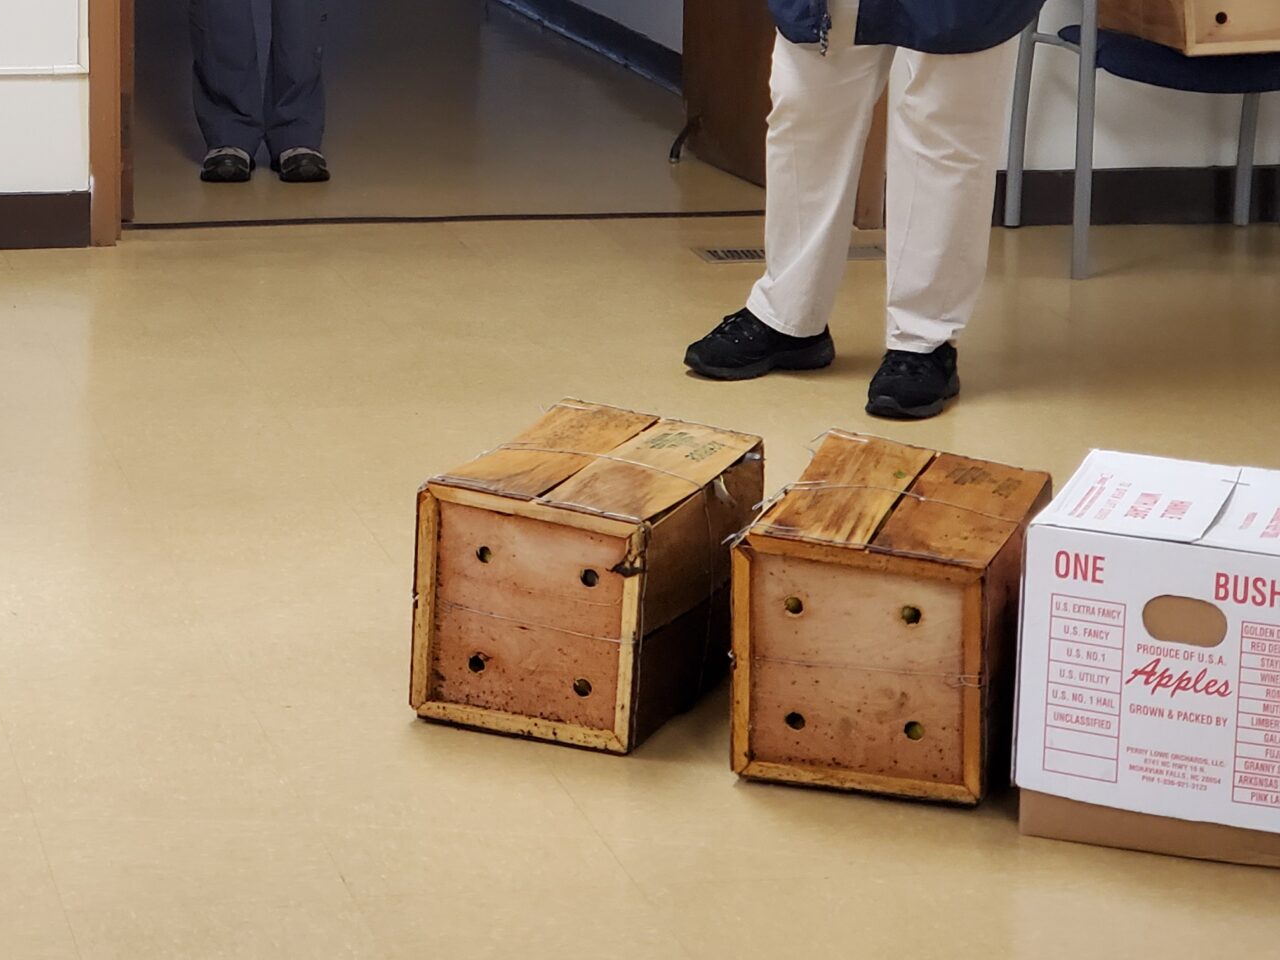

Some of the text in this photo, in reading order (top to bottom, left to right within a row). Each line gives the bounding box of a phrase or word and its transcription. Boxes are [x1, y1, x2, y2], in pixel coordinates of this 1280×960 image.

[1055, 550, 1280, 608] ONE BUSH
[1055, 601, 1122, 620] U.S. EXTRA FANCY
[1064, 625, 1110, 640] U.S. FANCY
[1243, 625, 1275, 638] GOLDEN
[1066, 648, 1083, 659] U.S.
[1251, 641, 1266, 652] RED
[1137, 644, 1226, 666] PRODUCE OF U.S.A.
[1059, 669, 1110, 685] U.S. UTILITY
[1125, 658, 1232, 698] Apples
[1052, 689, 1069, 701] U.S.
[1072, 693, 1086, 704] NO.
[1096, 697, 1115, 709] HAIL
[1053, 711, 1112, 730] UNCLASSIFIED
[1129, 703, 1228, 727] GROWN & PACKED BY
[1126, 746, 1148, 755] PERRY
[1128, 764, 1165, 776] MORAVIAN
[1244, 760, 1275, 774] GRANNY
[1251, 792, 1268, 802] PINK
